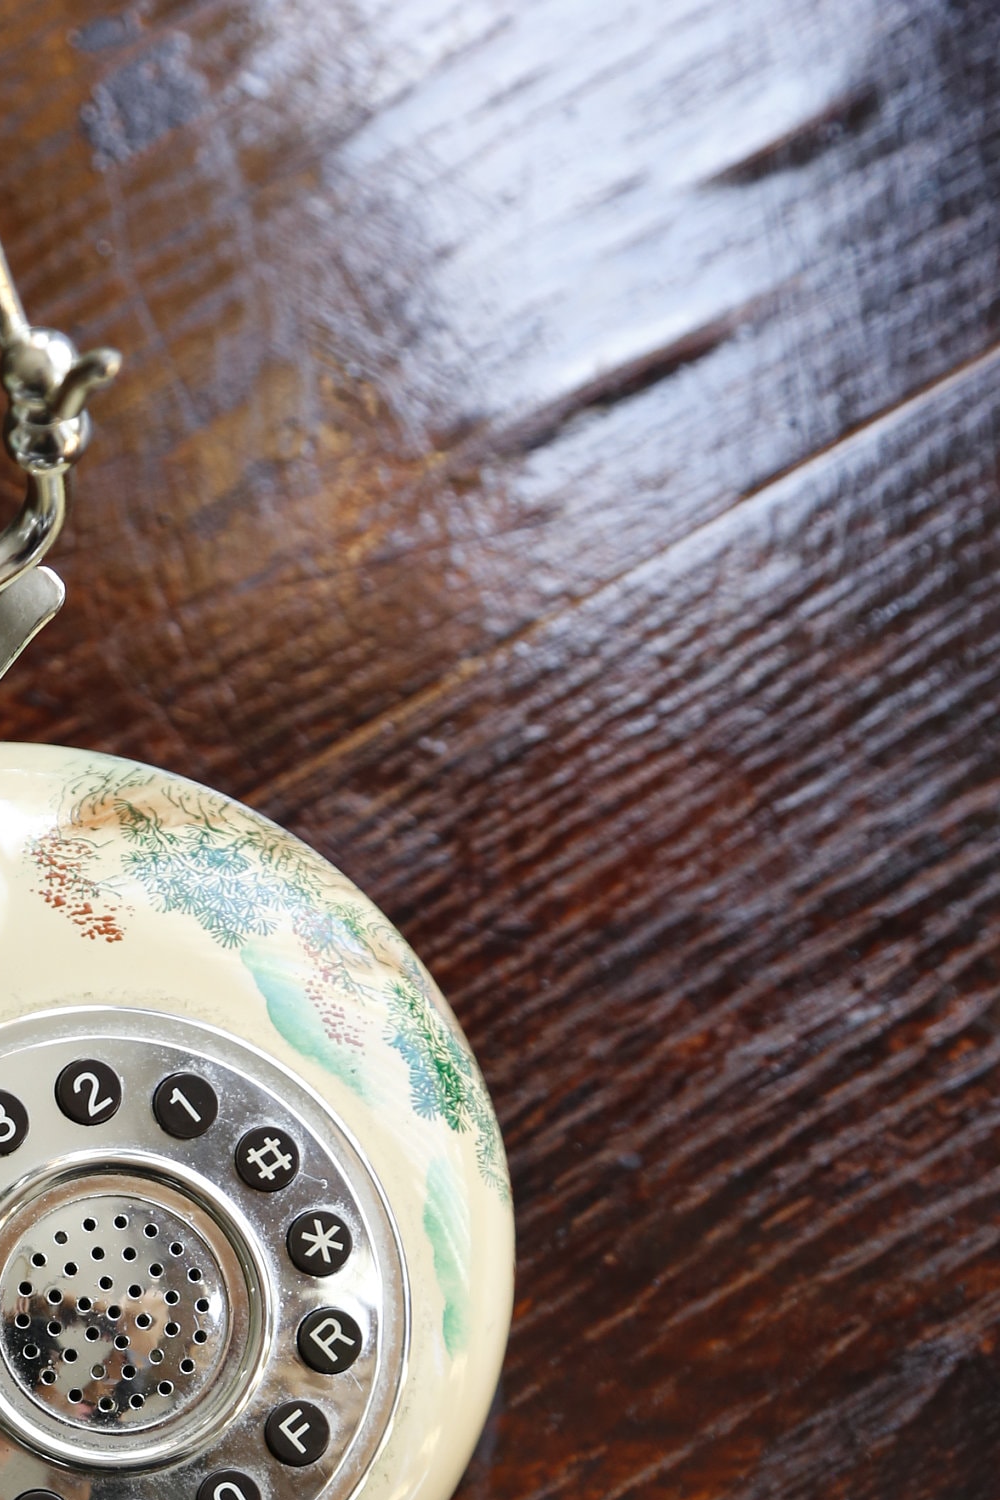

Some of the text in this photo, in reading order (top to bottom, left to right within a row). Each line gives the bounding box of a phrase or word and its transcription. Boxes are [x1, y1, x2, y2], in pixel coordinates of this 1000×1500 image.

[73, 1072, 113, 1117] 2
[169, 1087, 202, 1123] 1
[246, 1137, 292, 1180] #
[309, 1317, 355, 1362] R
[278, 1408, 310, 1454] F
